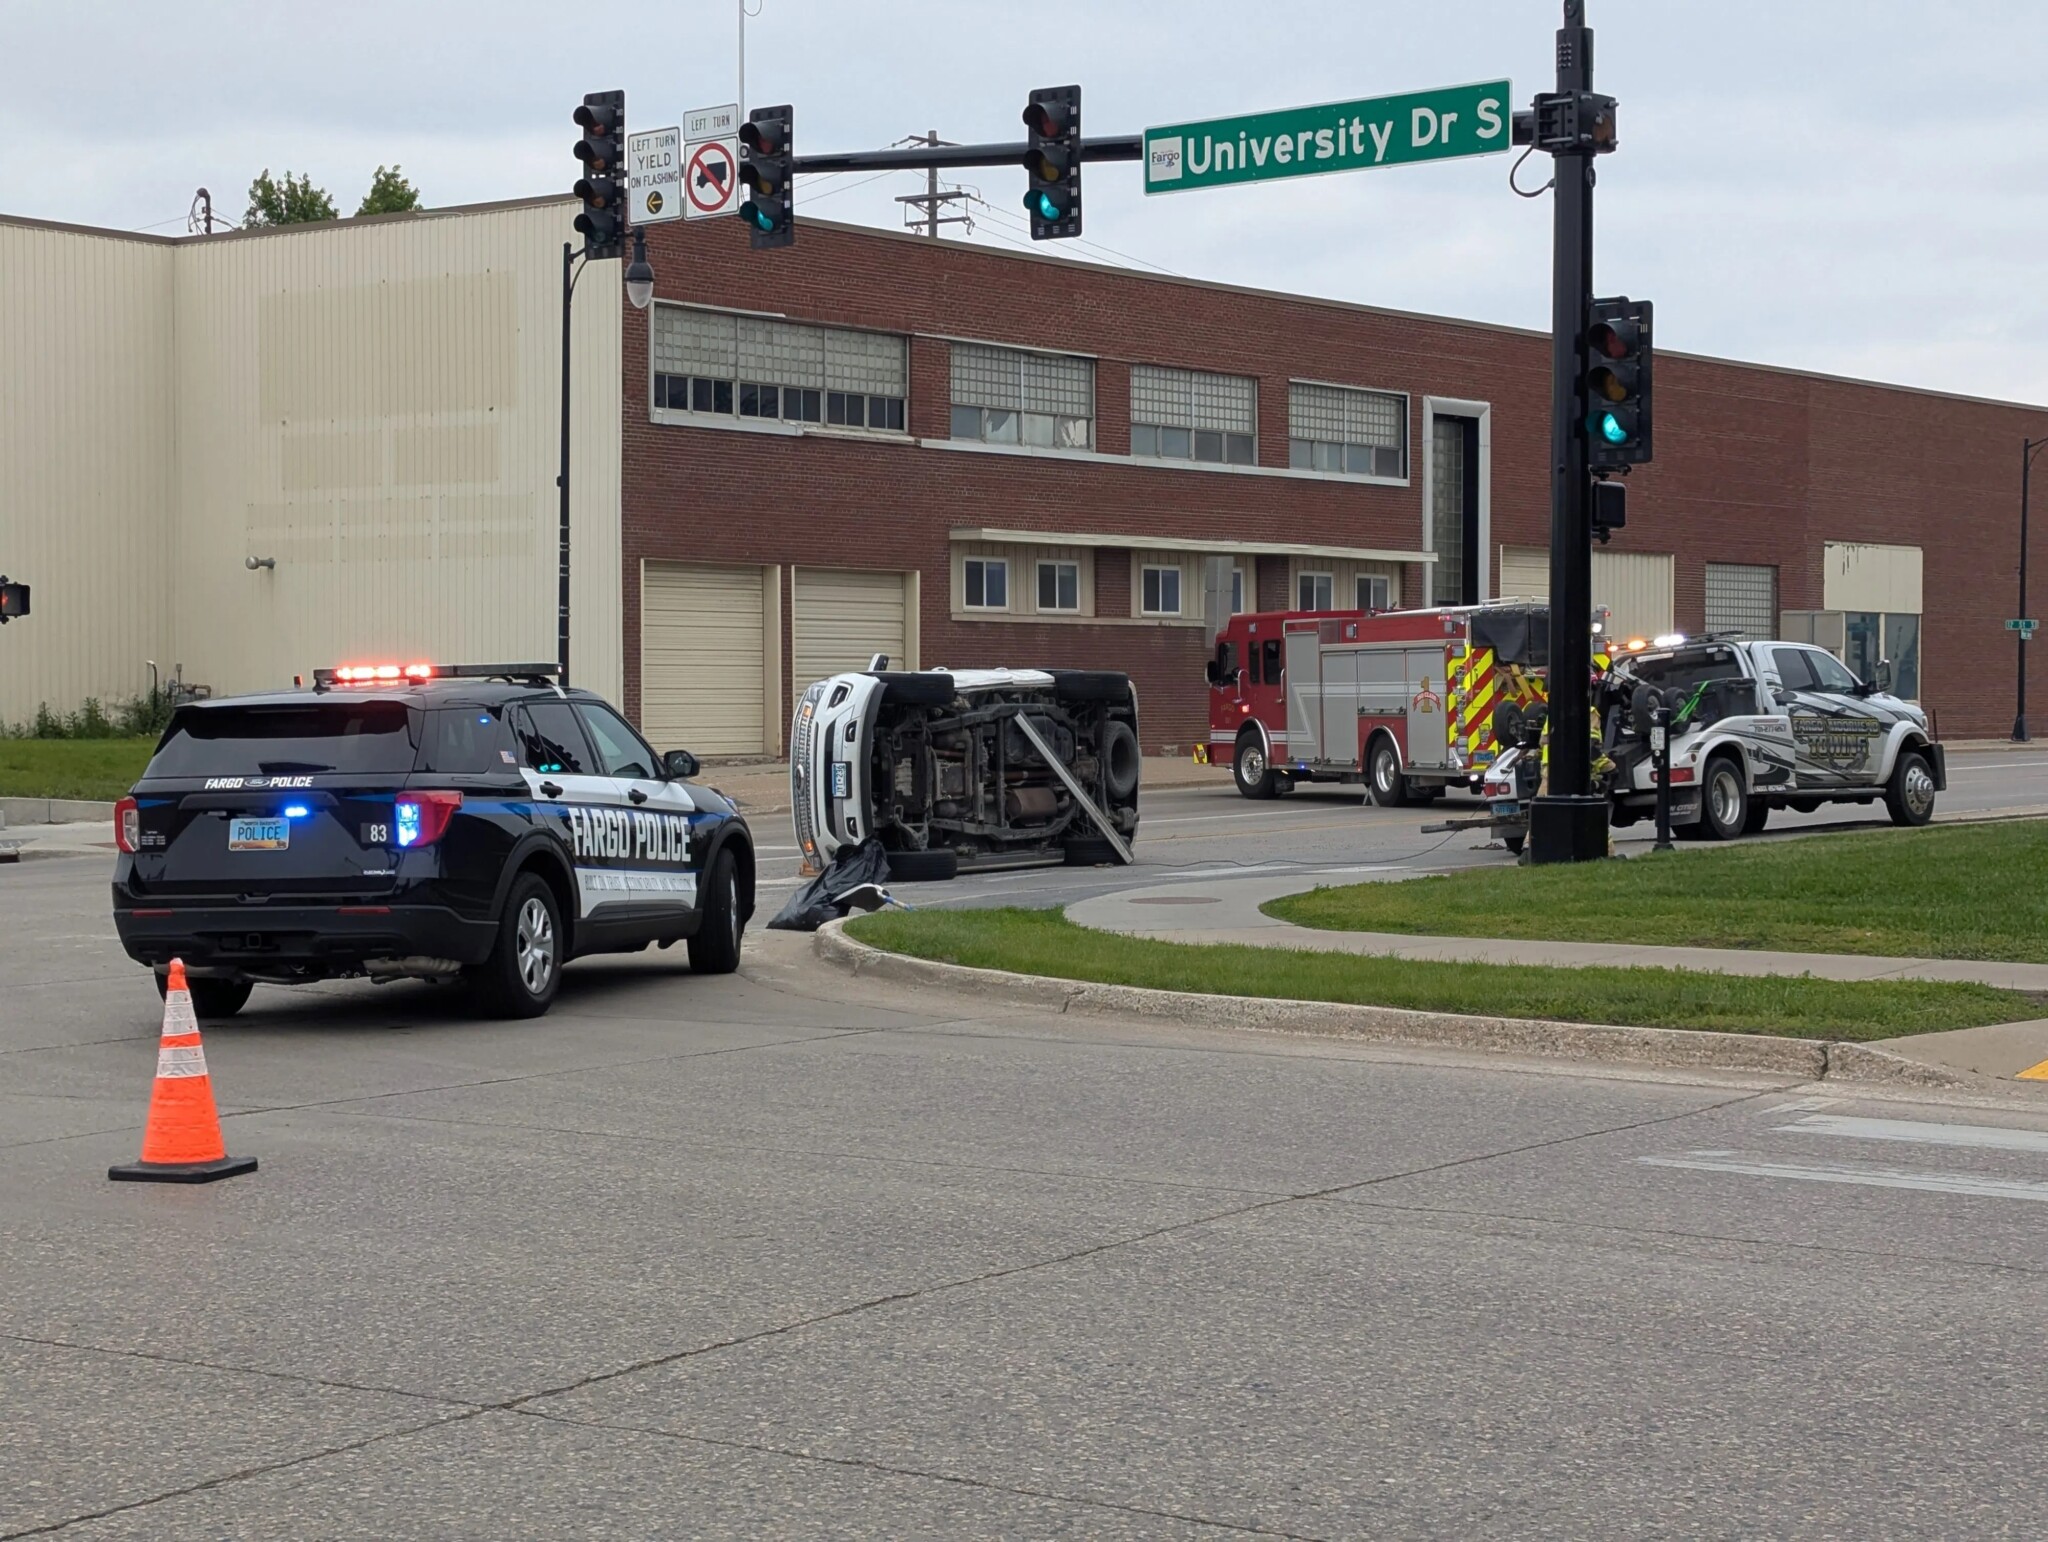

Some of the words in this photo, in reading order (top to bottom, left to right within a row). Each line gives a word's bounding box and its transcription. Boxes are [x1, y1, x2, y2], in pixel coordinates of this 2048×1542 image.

[691, 118, 707, 131] LEFT
[712, 114, 730, 128] TURN
[632, 140, 650, 152] LEFT
[655, 136, 676, 149] TURN
[1188, 116, 1394, 175] University
[1411, 106, 1459, 148] Dr
[1475, 97, 1503, 140] S
[637, 152, 671, 171] YIELD
[1152, 150, 1180, 165] Fargo
[631, 177, 641, 188] ON
[643, 170, 678, 187] FLASHING
[204, 778, 244, 790] FARGO
[269, 776, 314, 788] POLICE
[237, 826, 282, 841] POLICE
[369, 824, 388, 842] 83
[568, 807, 630, 858] FARGO
[633, 812, 691, 862] POLICE
